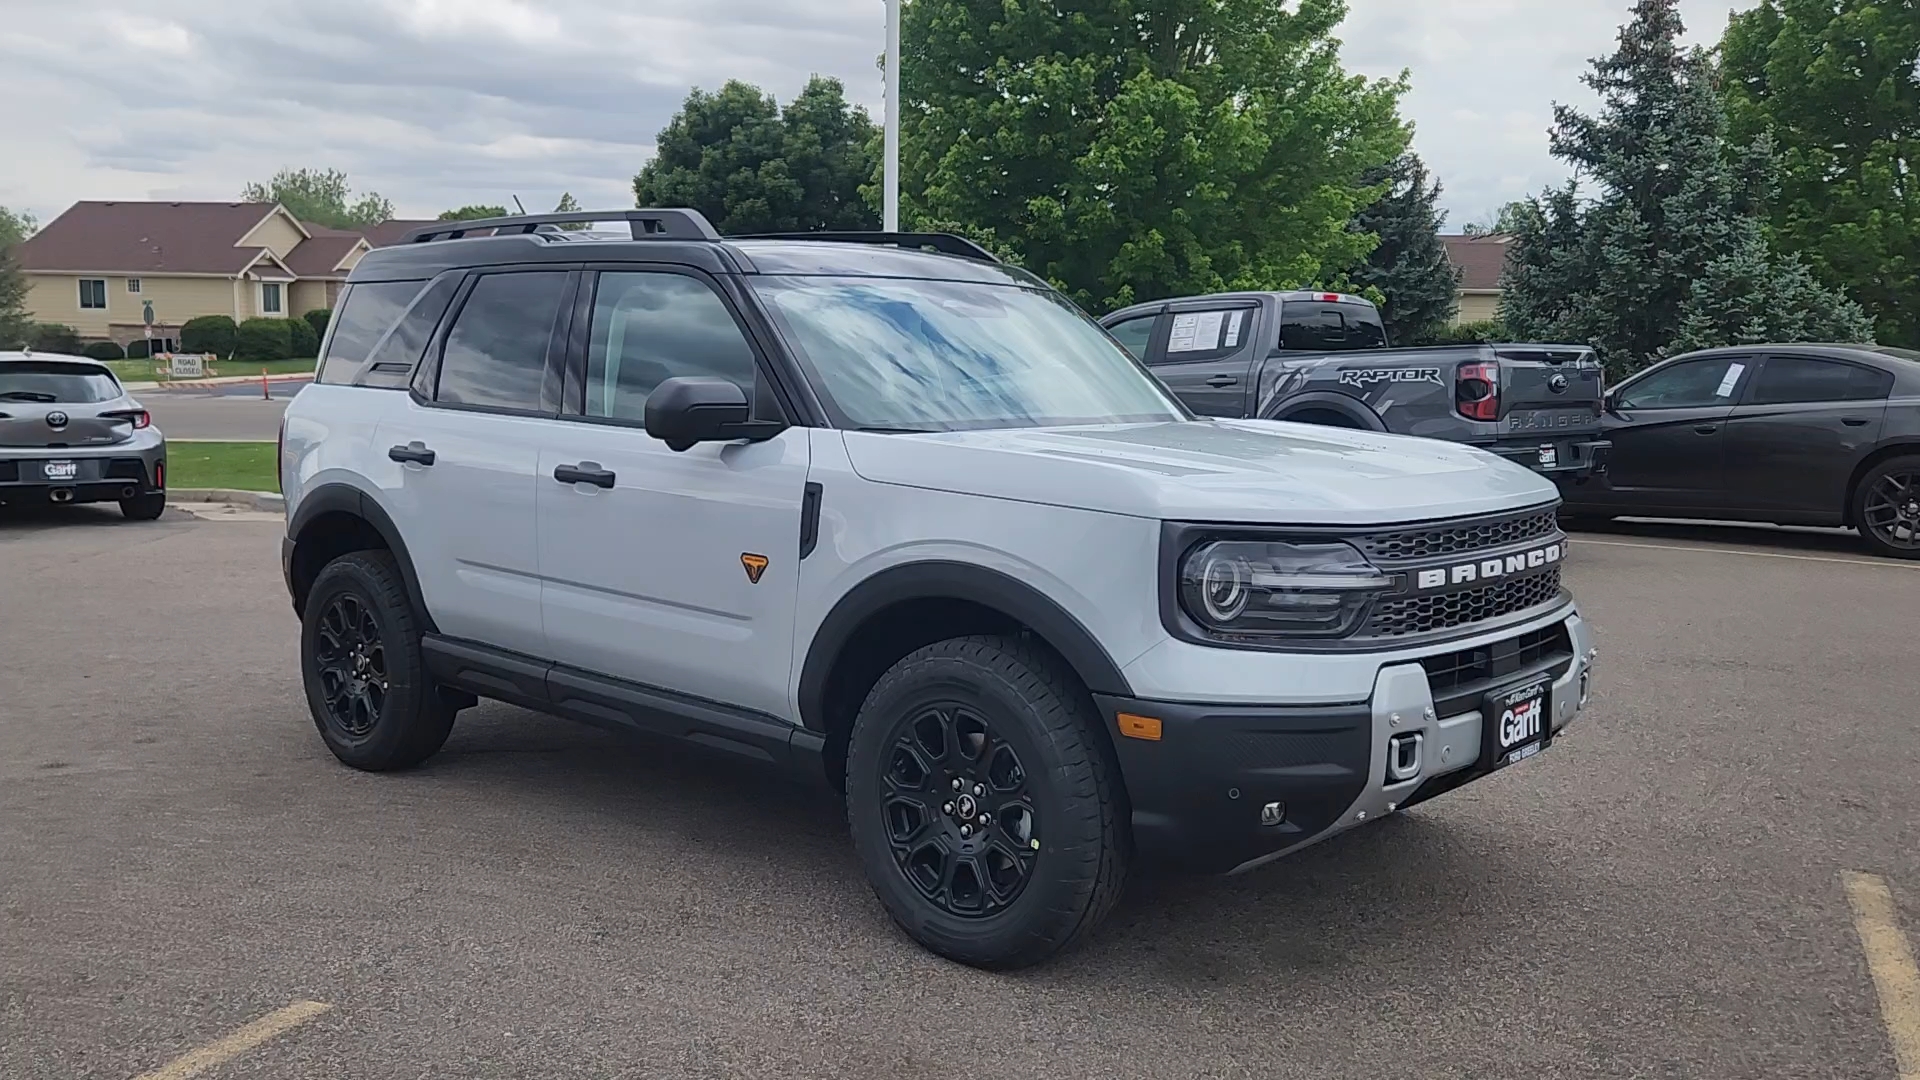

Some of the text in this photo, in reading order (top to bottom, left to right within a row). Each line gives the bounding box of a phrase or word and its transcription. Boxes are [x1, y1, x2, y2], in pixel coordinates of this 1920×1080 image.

[175, 367, 200, 375] CLOSED
[1339, 367, 1445, 388] RAPTOR
[1510, 415, 1593, 429] RANGER
[44, 463, 76, 476] Garff
[1418, 544, 1560, 589] BRONCO
[1500, 697, 1542, 748] Garff
